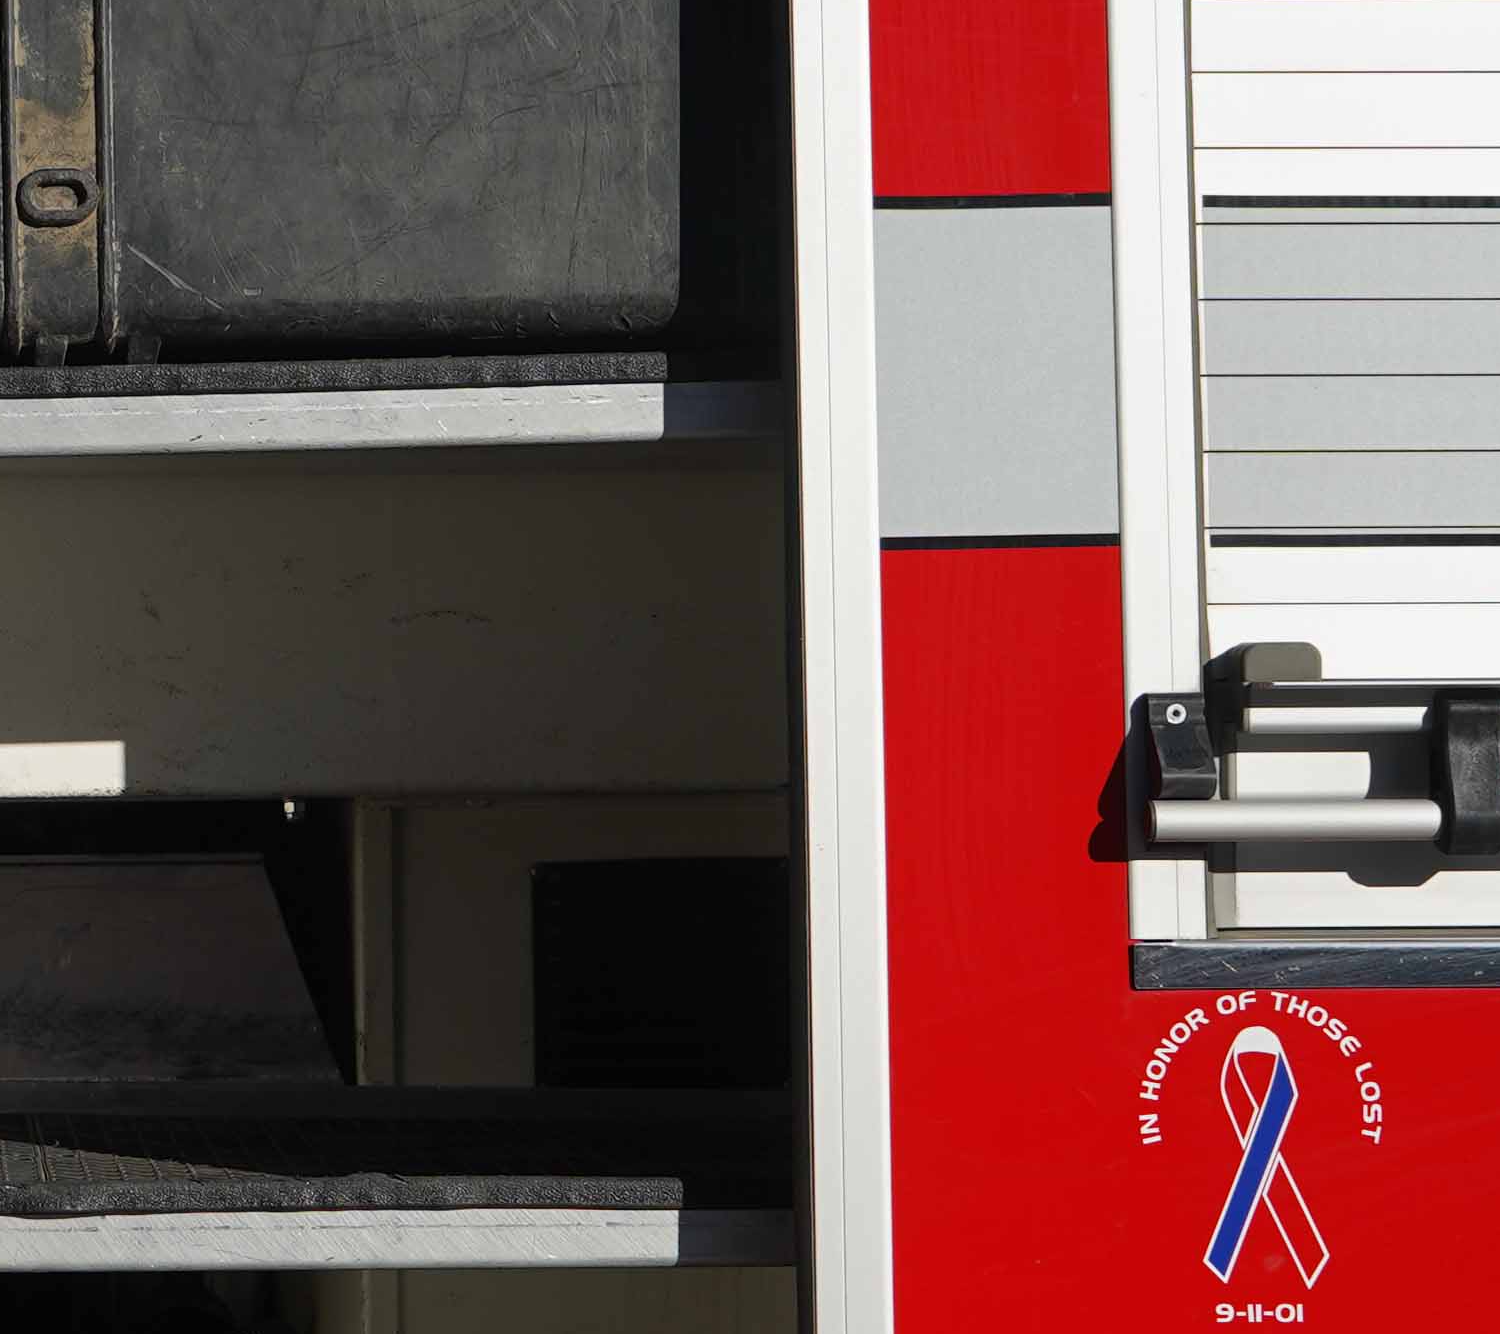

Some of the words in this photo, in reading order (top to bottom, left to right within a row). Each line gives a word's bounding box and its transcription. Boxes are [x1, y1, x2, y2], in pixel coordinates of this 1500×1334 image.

[1215, 990, 1257, 1016] OF
[1270, 990, 1362, 1058] THOSE
[1138, 1007, 1210, 1101] HONOR
[1354, 1061, 1383, 1145] LOST
[1138, 1112, 1164, 1146] IN
[1214, 1302, 1304, 1324] 9-11-01
